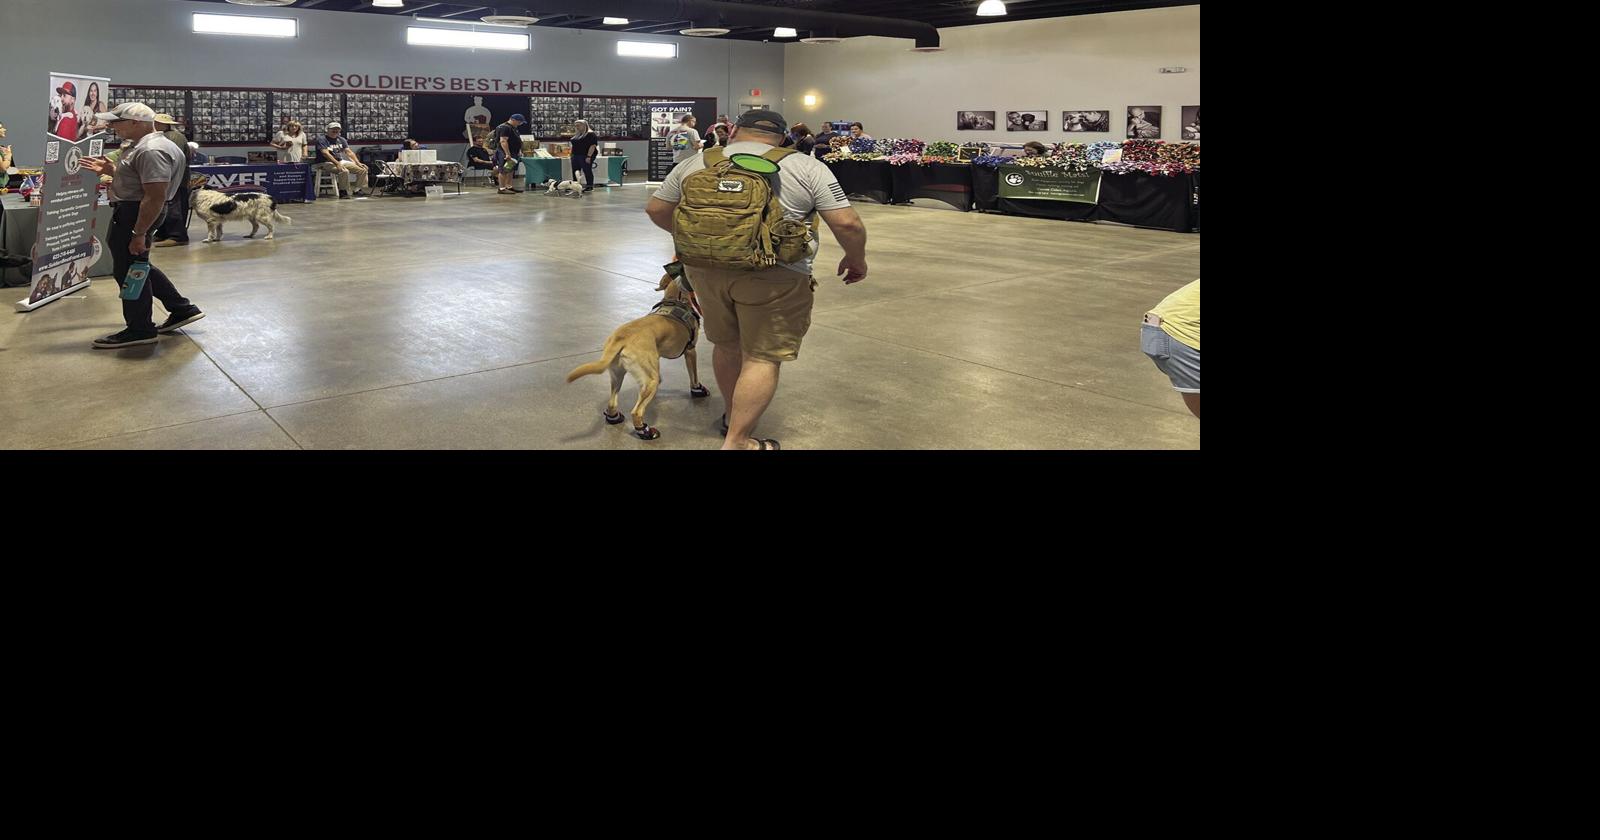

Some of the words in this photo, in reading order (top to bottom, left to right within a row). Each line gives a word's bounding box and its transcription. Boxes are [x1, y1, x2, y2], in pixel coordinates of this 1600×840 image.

[329, 73, 446, 90] SOLDIER'S
[450, 77, 502, 91] BEST
[519, 80, 582, 93] FRIEND
